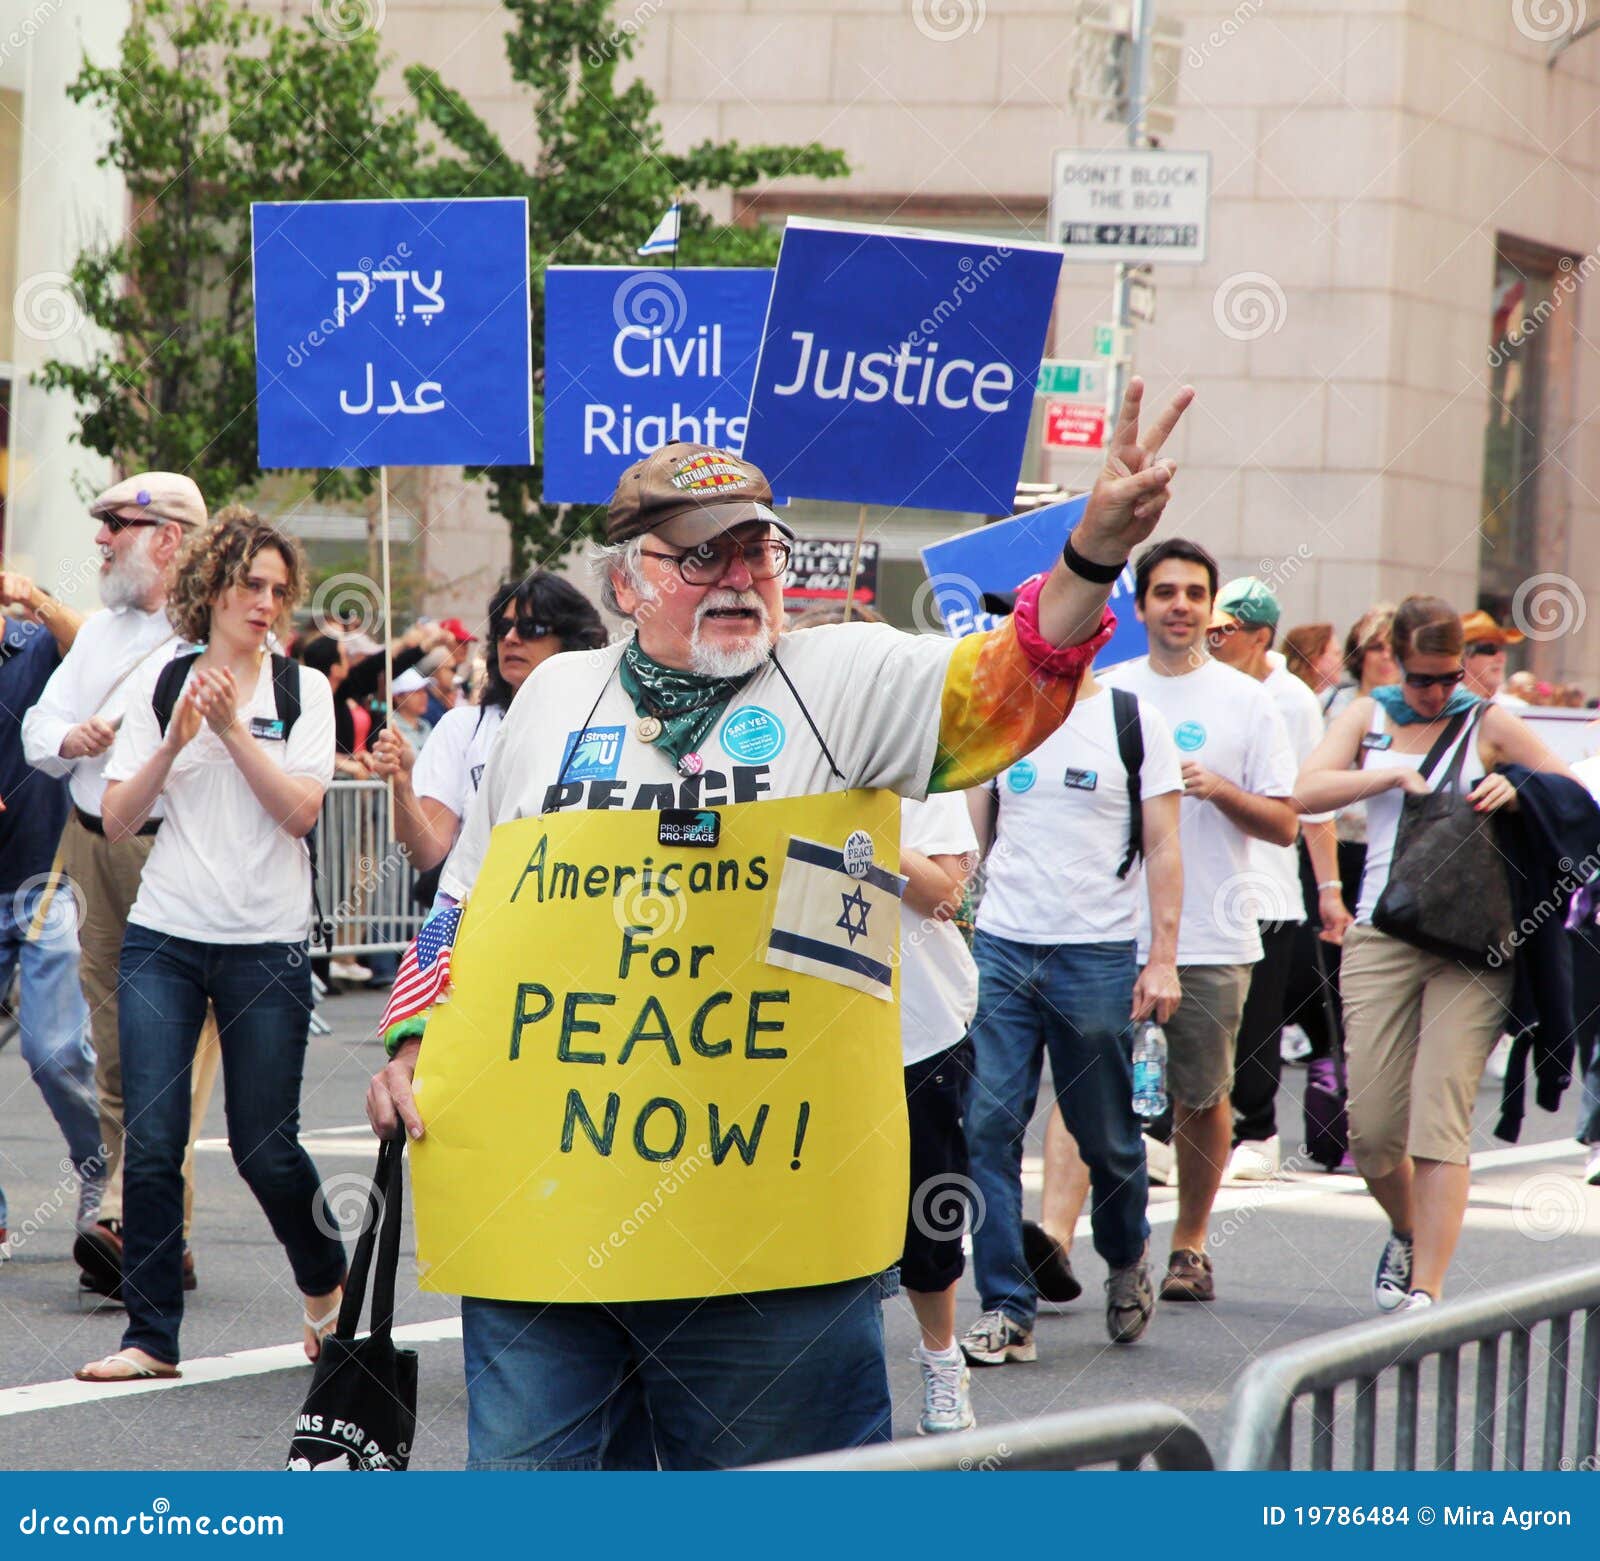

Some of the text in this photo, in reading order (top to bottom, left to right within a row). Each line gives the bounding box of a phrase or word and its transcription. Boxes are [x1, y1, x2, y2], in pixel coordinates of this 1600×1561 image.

[1063, 164, 1197, 188] DON'T BLOCK
[1090, 189, 1173, 211] THE BOX
[613, 323, 722, 378] Civil
[774, 331, 1014, 413] Justice
[339, 362, 446, 415] عدل
[584, 402, 747, 463] Rights
[671, 464, 713, 489] VIETNAM
[585, 731, 620, 742] Street
[727, 721, 747, 736] SAY
[748, 715, 768, 728] YES
[599, 740, 618, 765] U
[541, 765, 771, 813] PEACE
[659, 832, 715, 843] PRO-PEACE
[660, 824, 714, 834] PRO-ISRAEL
[848, 845, 874, 860] PEACE
[510, 833, 769, 903] Americans
[618, 925, 715, 979] For
[508, 982, 790, 1066] PEACE
[330, 1419, 365, 1447] FOR
